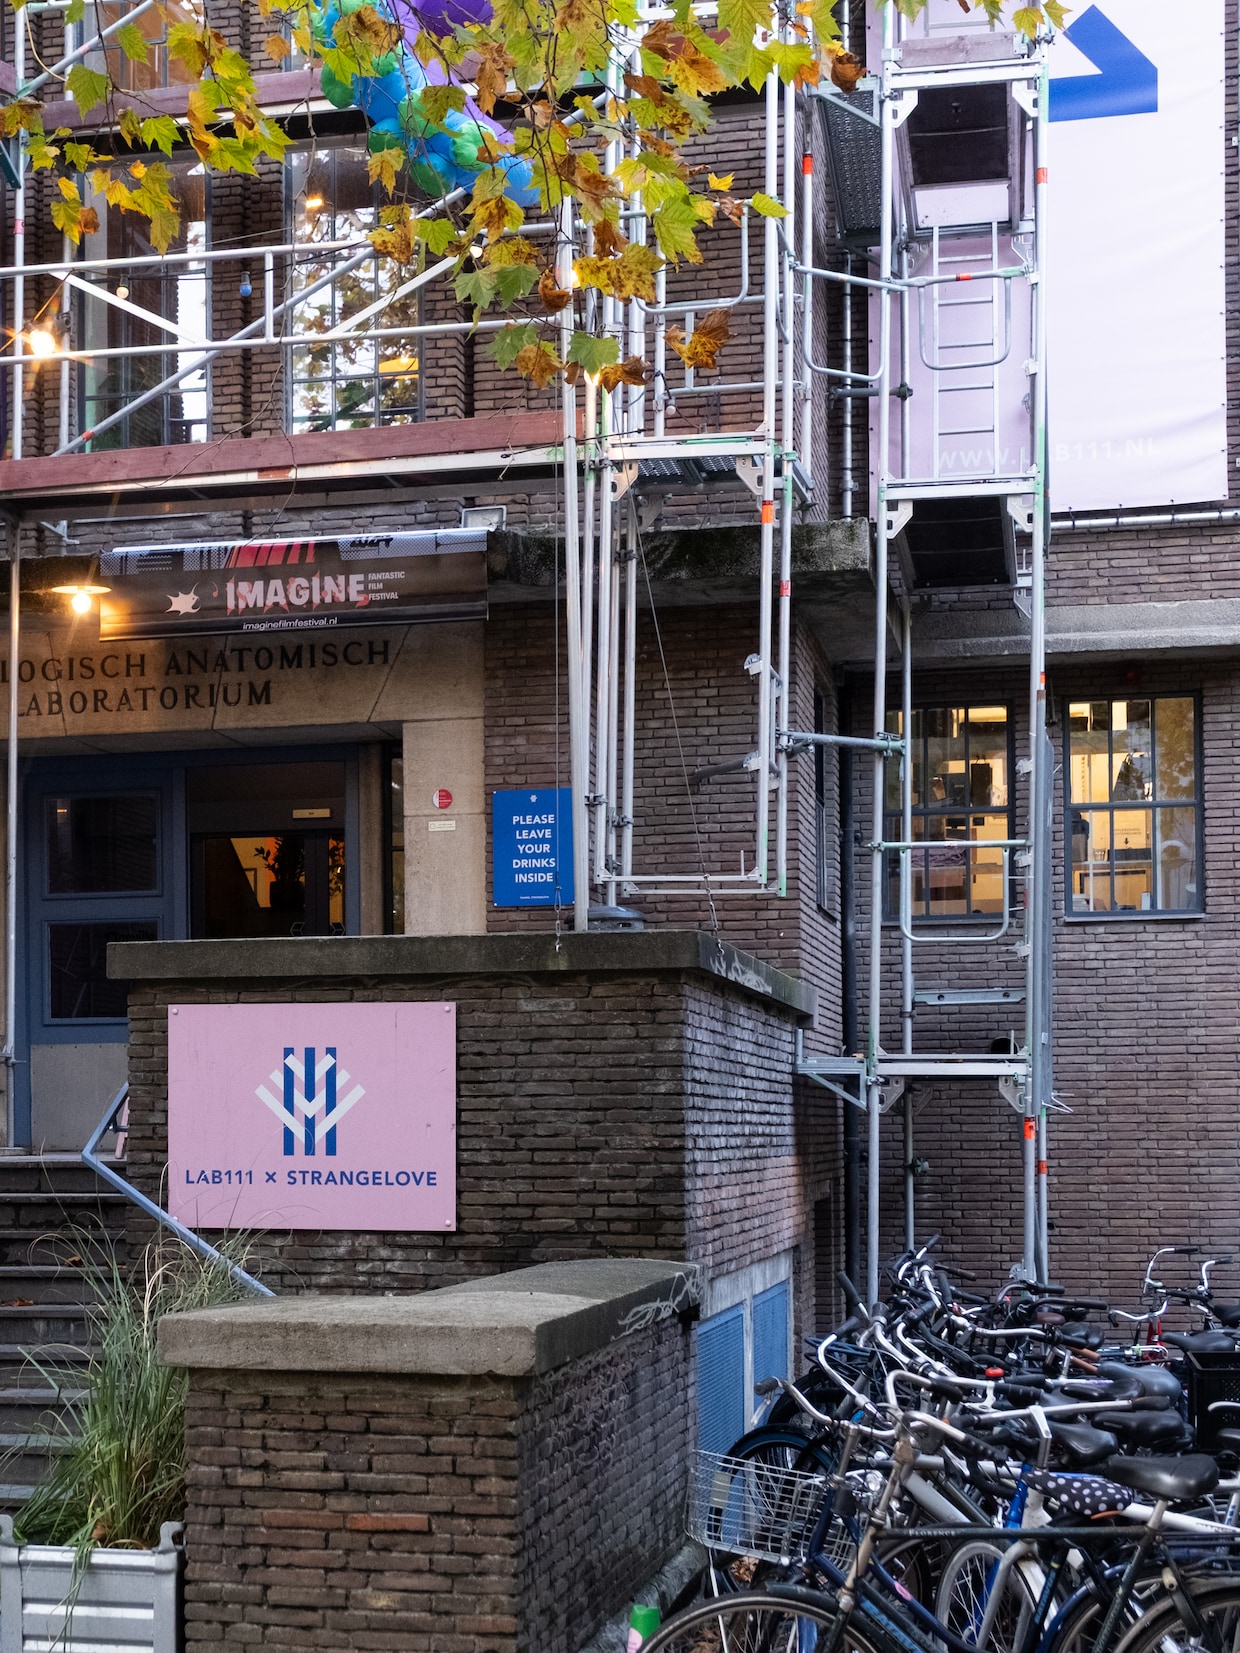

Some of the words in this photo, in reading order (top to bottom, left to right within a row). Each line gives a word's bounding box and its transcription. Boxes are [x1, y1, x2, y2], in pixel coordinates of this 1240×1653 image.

[937, 438, 1159, 468] WWW.LB111.NL
[368, 571, 406, 581] FANTASTIC
[226, 573, 366, 609] IMAGINE
[368, 582, 384, 590] FILM
[368, 592, 399, 601] FESTIVAL
[242, 616, 338, 632] imaginefilmfestival.nl
[164, 640, 390, 676] ANATOMISCH
[512, 814, 555, 825] PLEASE
[515, 829, 552, 840] LEAVE
[517, 843, 551, 854] YOUR
[512, 858, 556, 869] DRINKS
[515, 872, 554, 883] INSIDE
[185, 1169, 254, 1185] LAB111
[287, 1169, 438, 1186] STRANGELOVE
